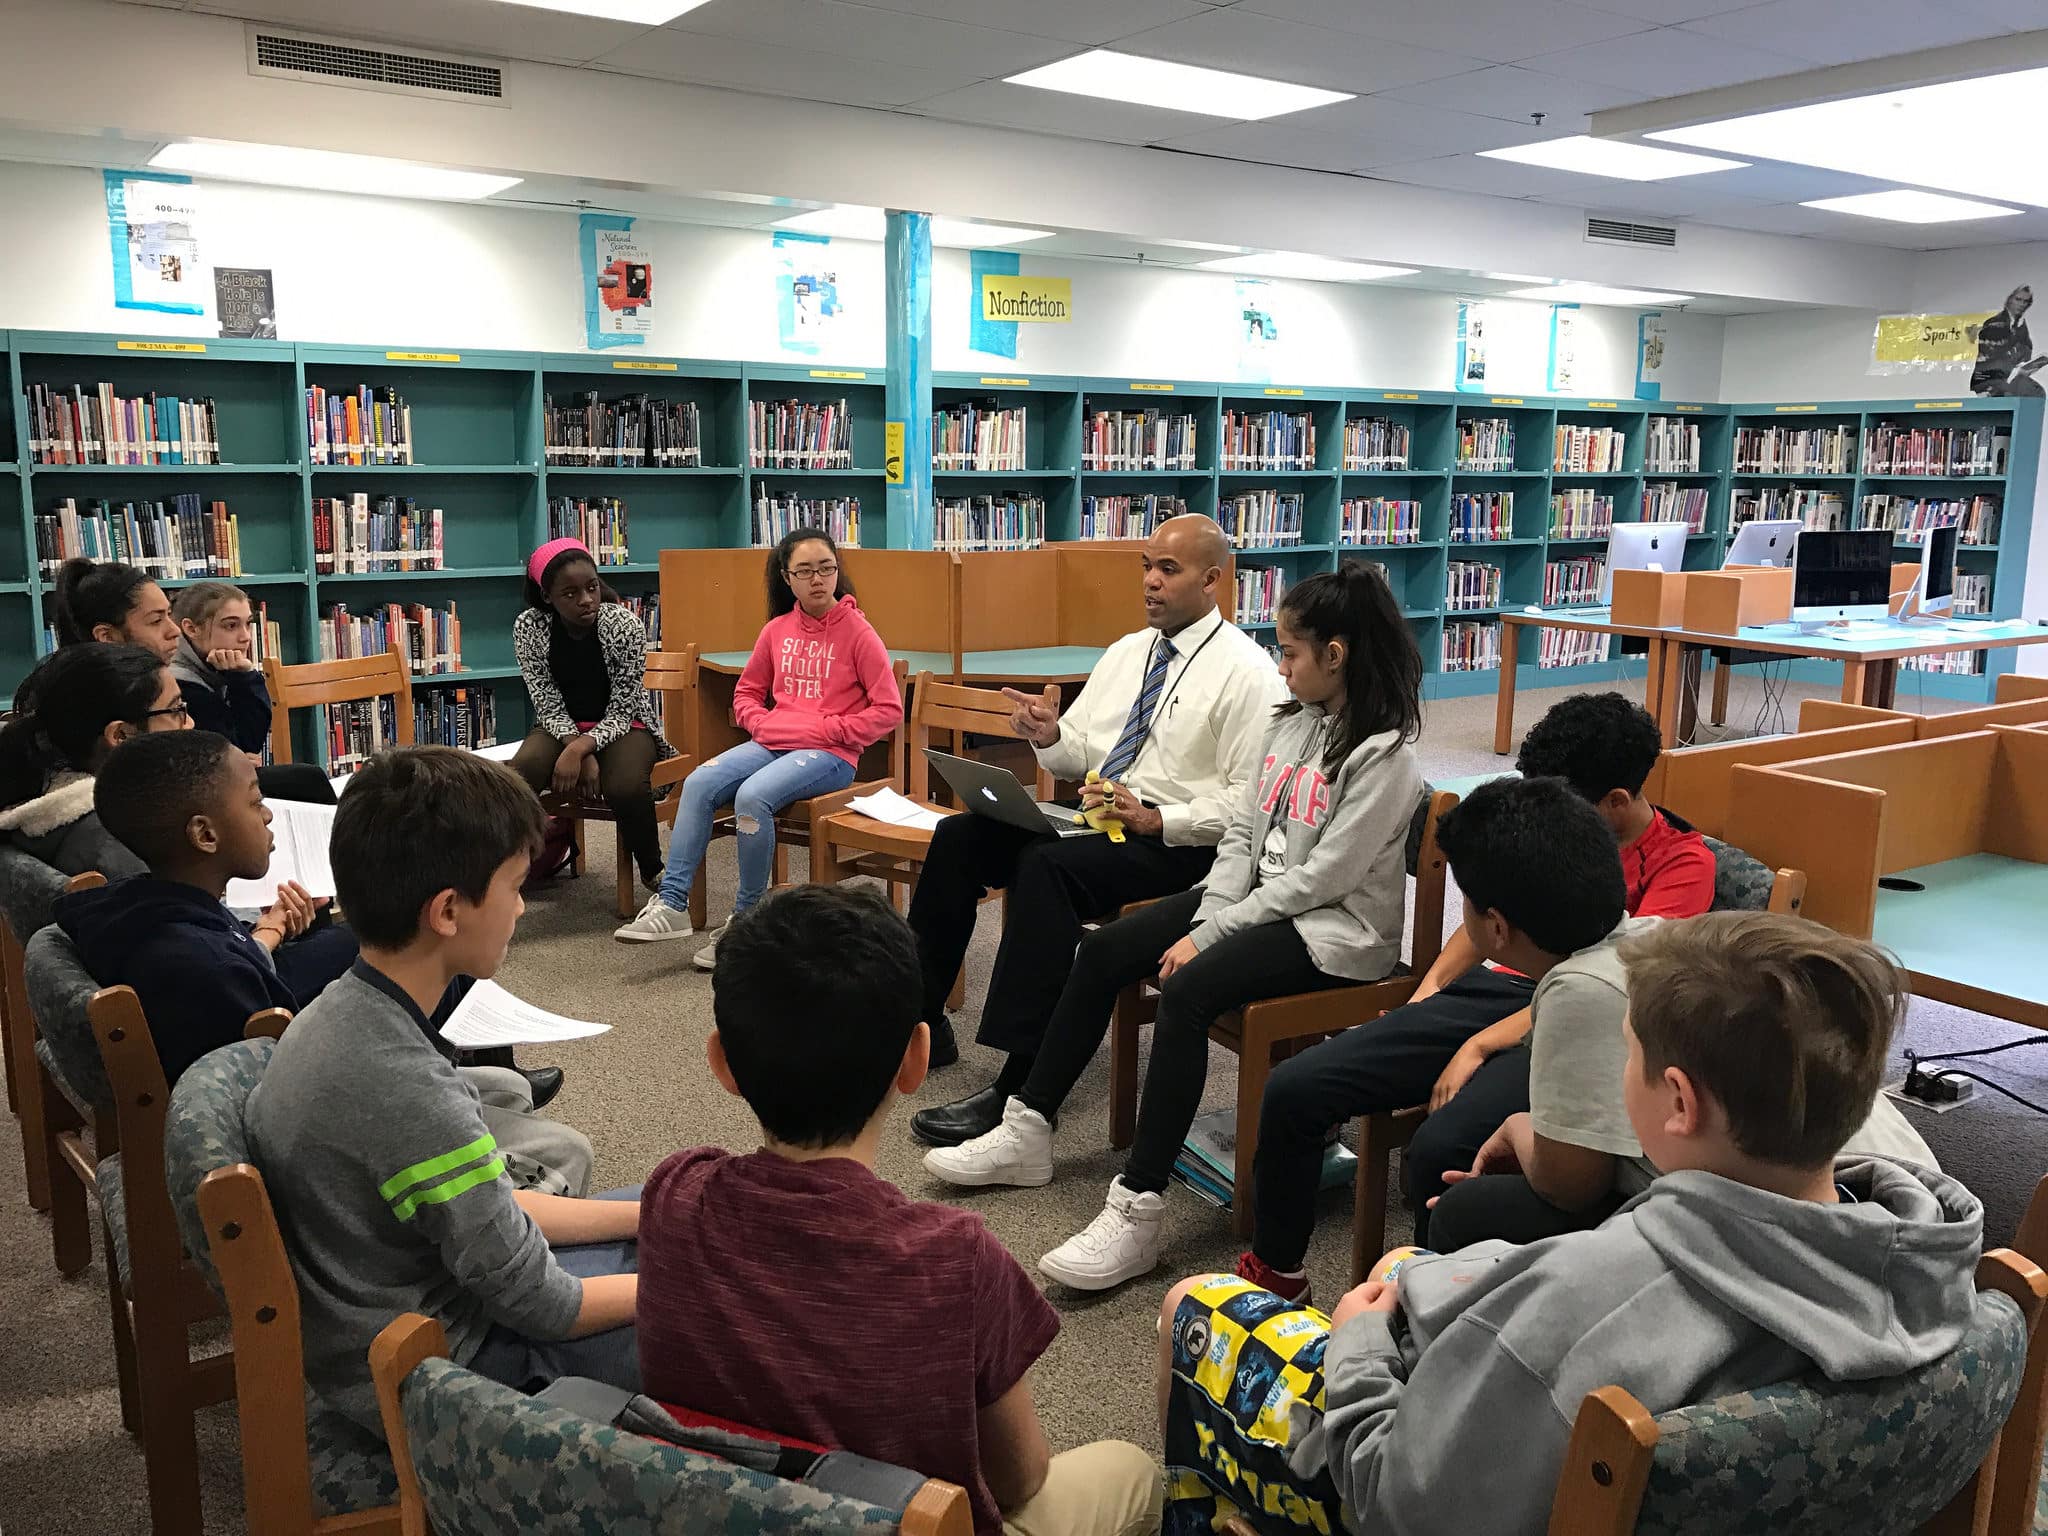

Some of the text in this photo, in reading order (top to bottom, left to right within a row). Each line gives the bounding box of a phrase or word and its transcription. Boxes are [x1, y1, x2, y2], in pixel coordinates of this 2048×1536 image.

[232, 273, 267, 288] Black
[224, 288, 252, 301] Hole
[989, 291, 1066, 318] Nonfiction
[225, 301, 251, 315] NOT
[1923, 326, 1961, 346] Sports
[781, 637, 836, 660] SO-CAL
[781, 655, 831, 679] HOLLI
[783, 677, 823, 699] STER
[457, 703, 471, 747] UNIVERS
